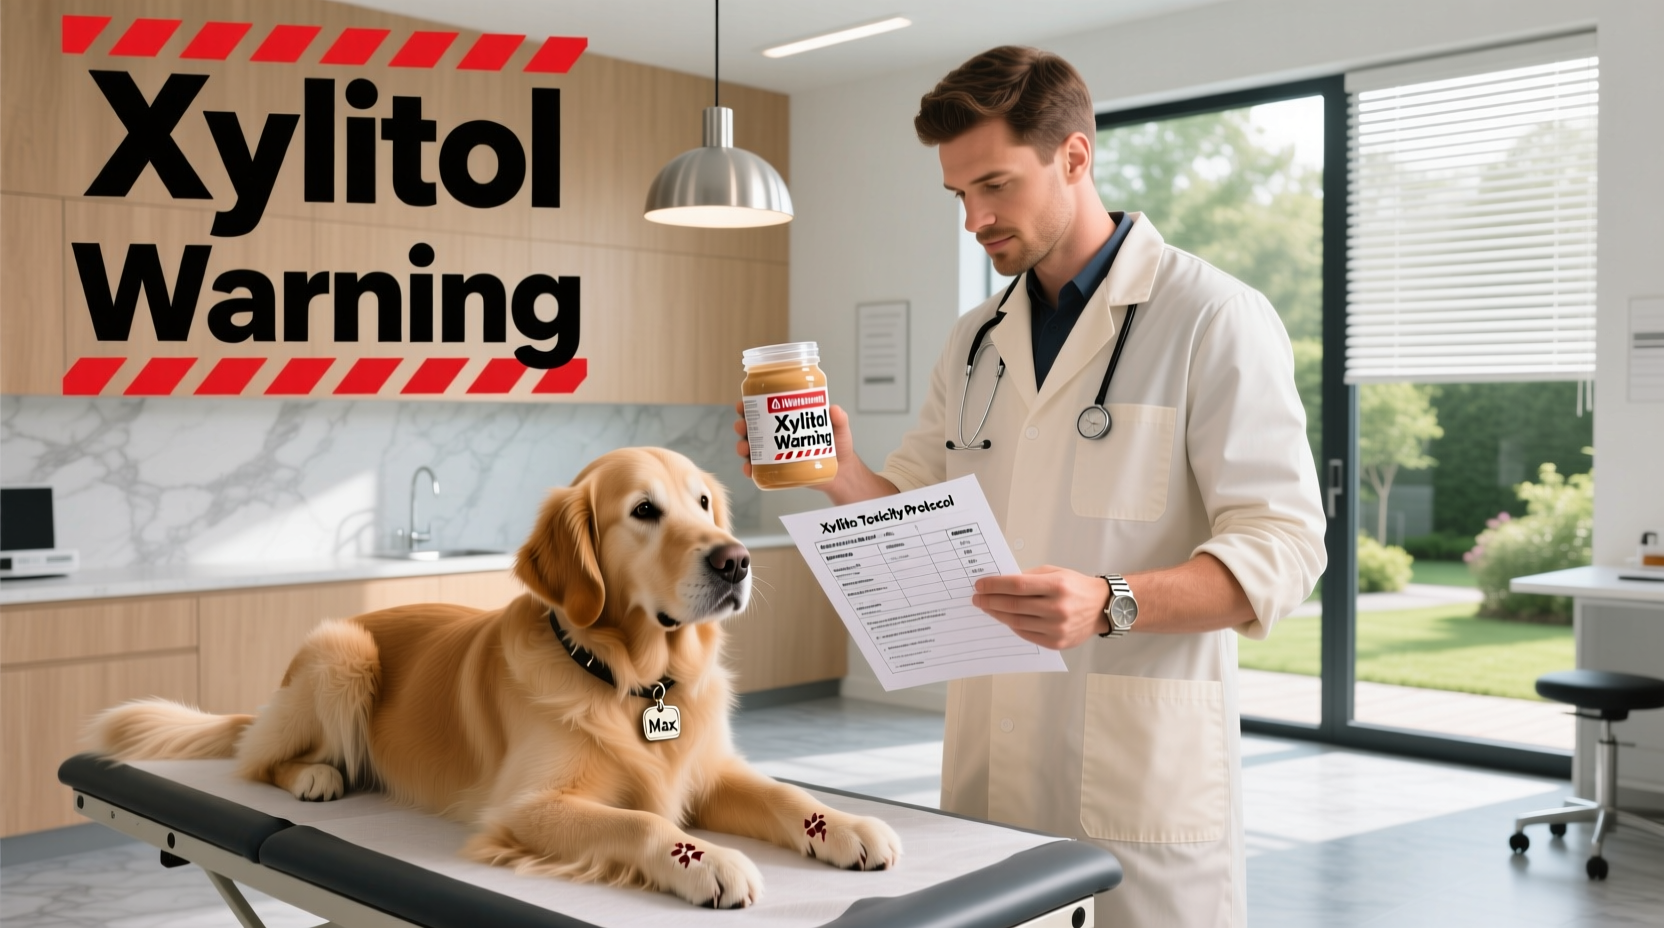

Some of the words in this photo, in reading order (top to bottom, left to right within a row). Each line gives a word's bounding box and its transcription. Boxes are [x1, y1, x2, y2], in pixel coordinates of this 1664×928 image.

[774, 408, 828, 434] Xylitol
[774, 430, 832, 450] Warning
[649, 717, 678, 734] Max
